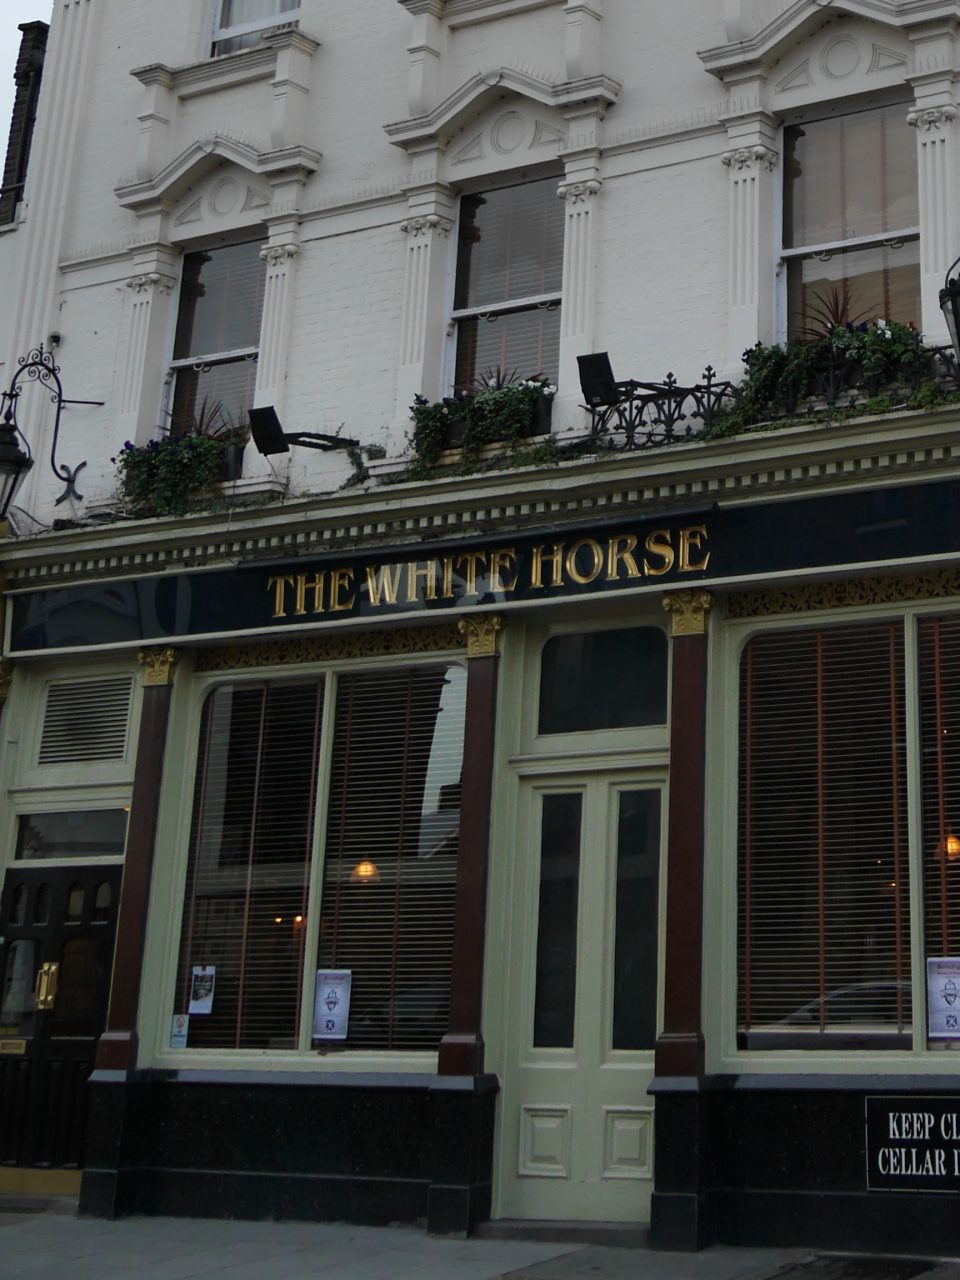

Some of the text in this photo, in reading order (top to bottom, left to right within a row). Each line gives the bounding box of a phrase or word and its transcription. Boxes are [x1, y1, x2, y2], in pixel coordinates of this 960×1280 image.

[267, 524, 712, 618] THE WHITE HORSE
[888, 1112, 935, 1140] KEEP
[878, 1147, 946, 1176] CELLAR
